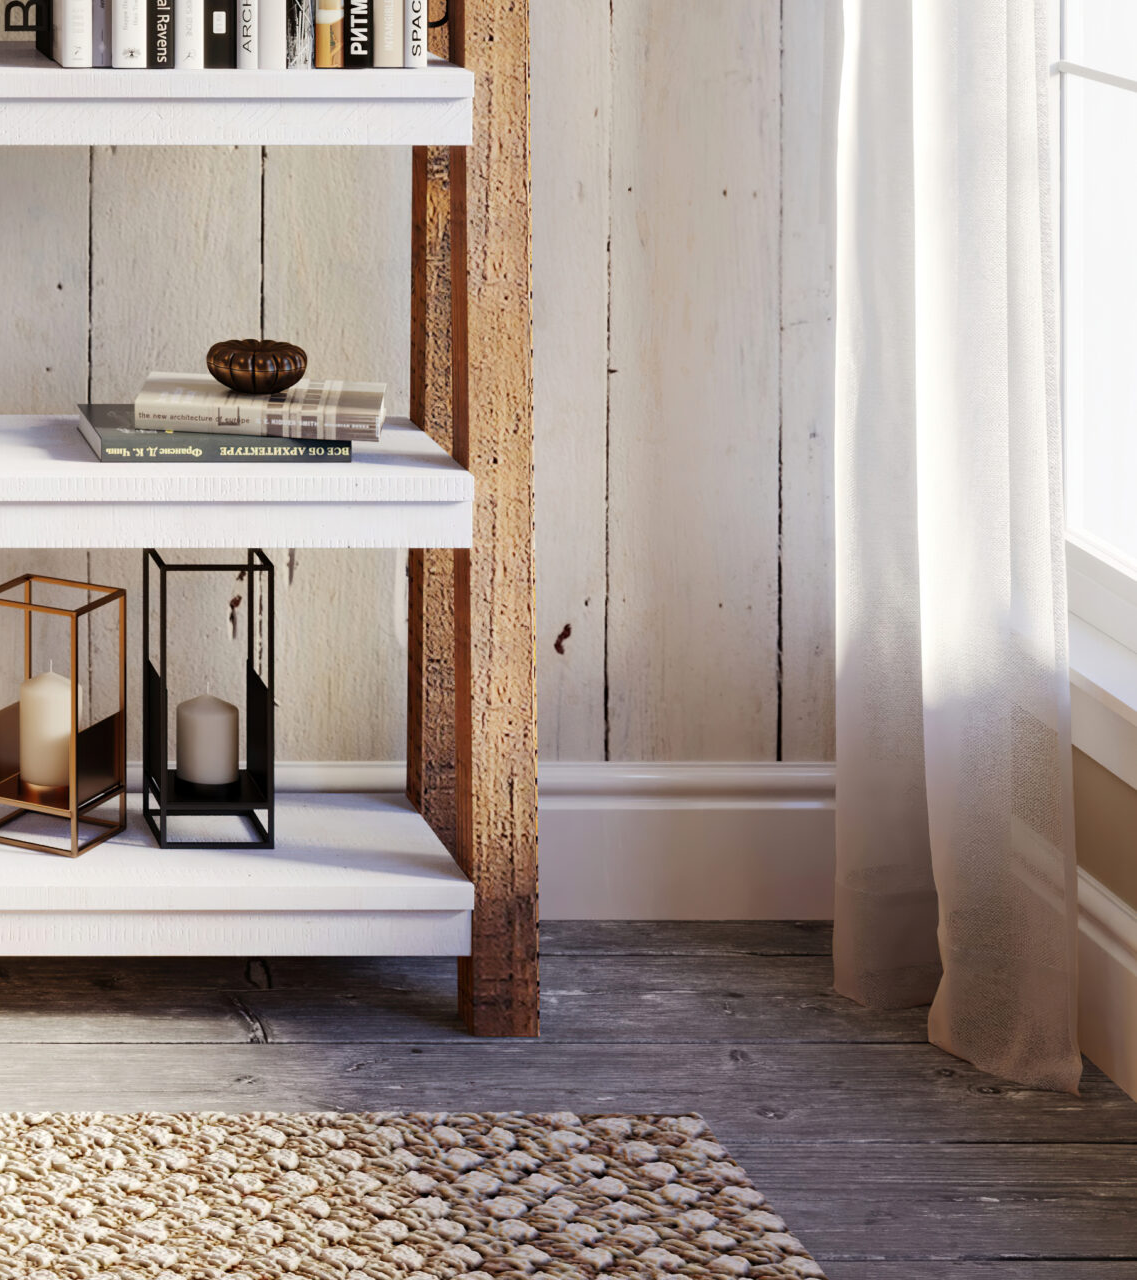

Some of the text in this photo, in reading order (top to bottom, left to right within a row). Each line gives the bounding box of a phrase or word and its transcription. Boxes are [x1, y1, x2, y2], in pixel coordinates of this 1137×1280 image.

[156, 14, 170, 63] Ravens
[169, 414, 213, 422] architecture
[219, 447, 350, 456] ВСЕ ОБ АРХИТЕКТУРЕ
